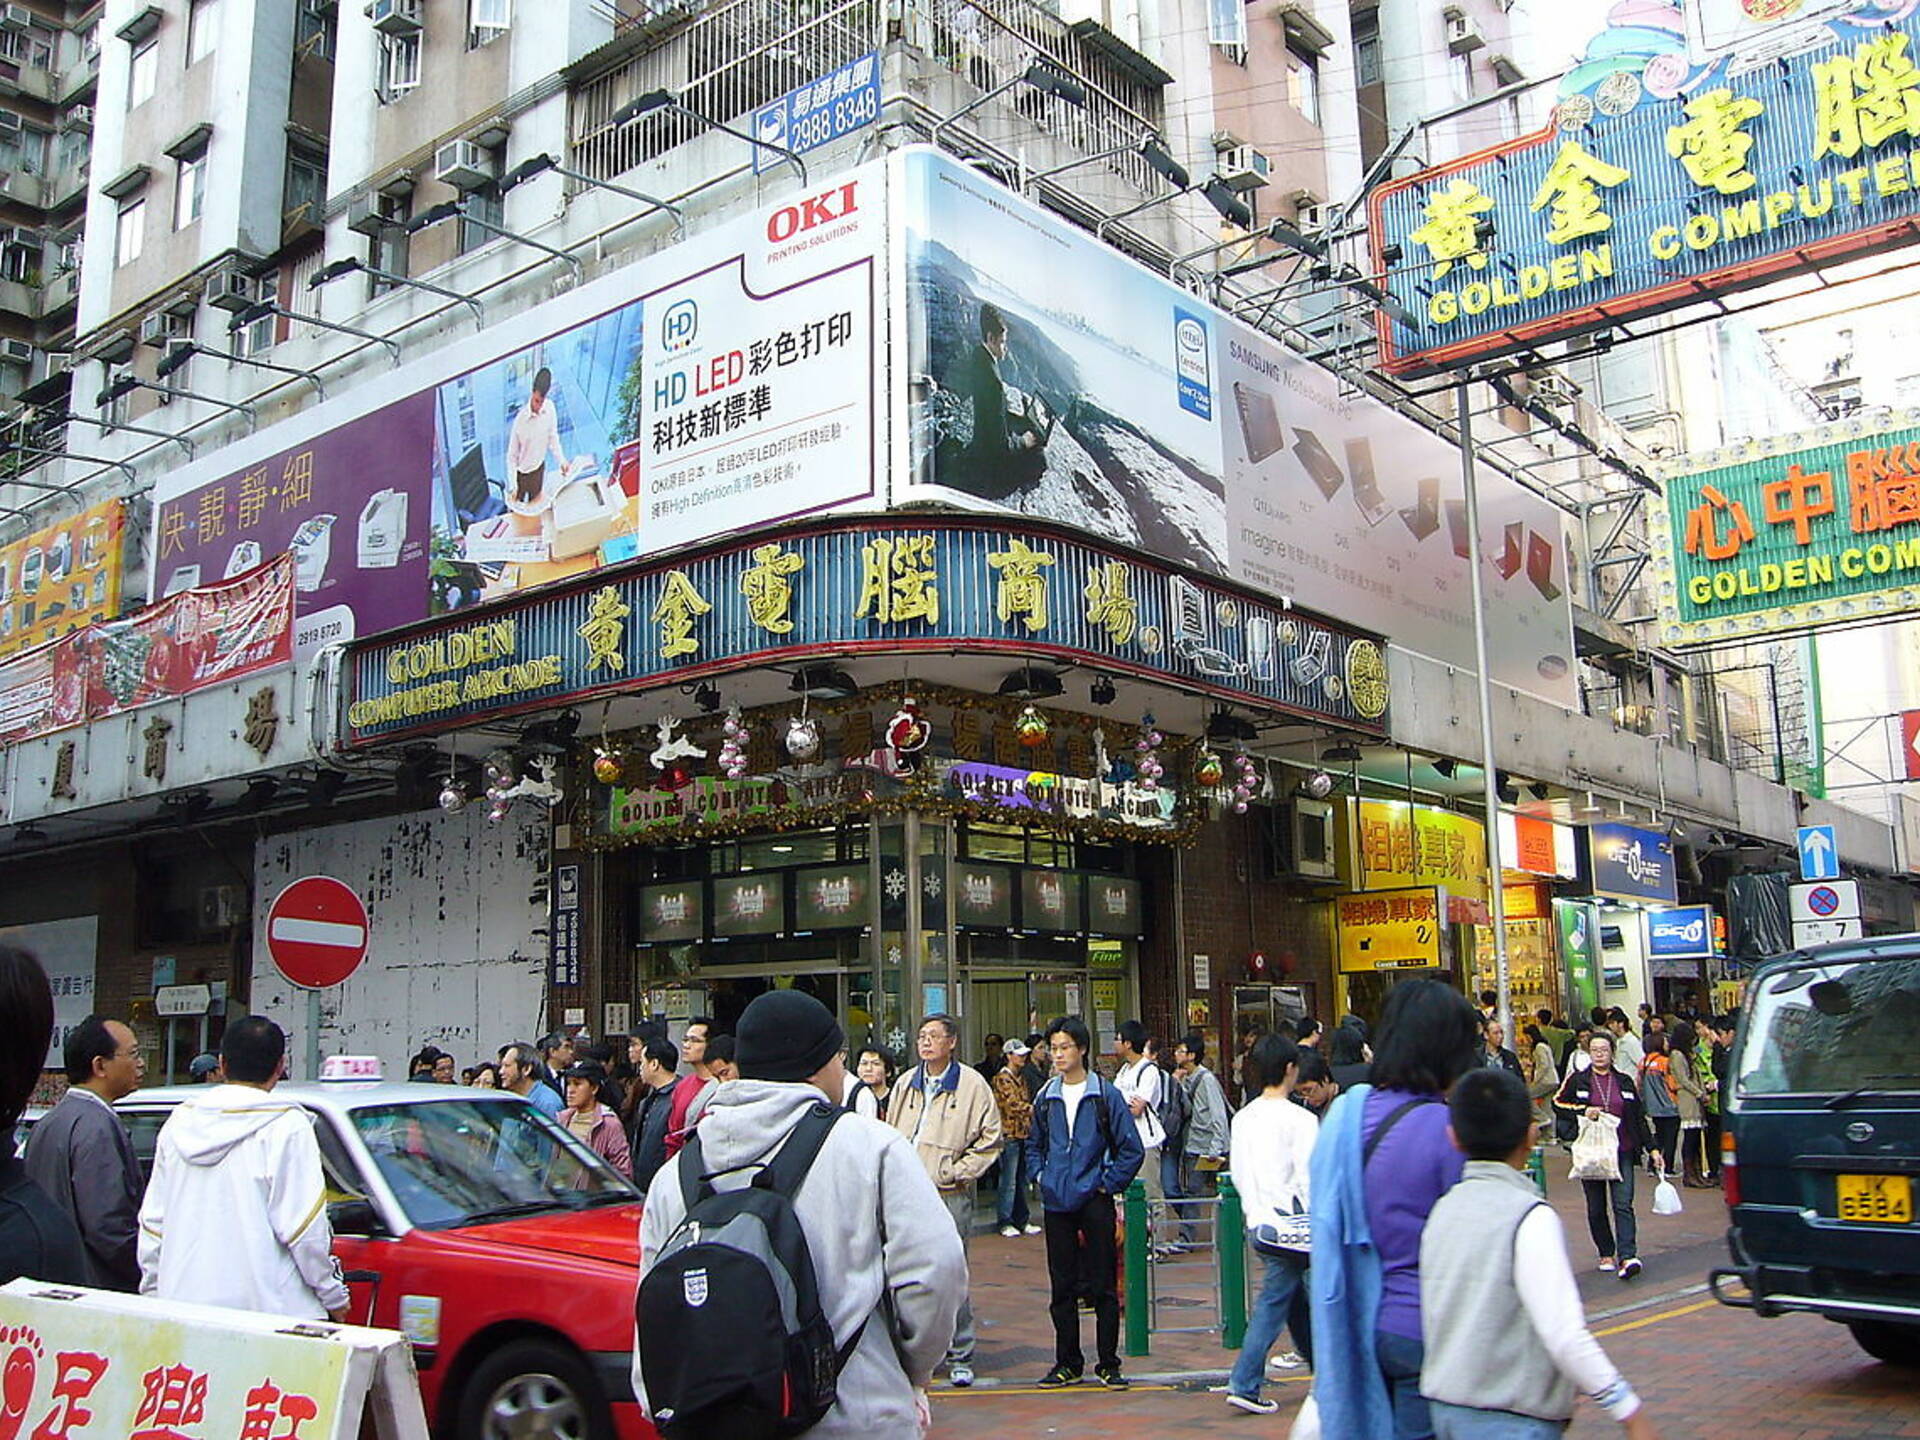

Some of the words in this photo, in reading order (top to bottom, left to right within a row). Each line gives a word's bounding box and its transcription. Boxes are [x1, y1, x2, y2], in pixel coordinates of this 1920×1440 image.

[793, 109, 832, 152] 2988
[835, 87, 877, 132] 8348
[767, 180, 858, 243] OKI
[1428, 244, 1614, 325] GOLDEN
[667, 312, 692, 340] HD
[654, 371, 687, 412] HD
[695, 350, 744, 397] LED
[749, 311, 852, 376] 彩色打印
[1229, 340, 1280, 382] SAMSUNG
[652, 384, 772, 455] 科技新標準
[1241, 521, 1287, 559] imagine
[1689, 555, 1833, 604] GOLDEN
[387, 619, 516, 683] GOLDEN
[349, 680, 462, 728] COMPUTER
[463, 655, 562, 701] ARCADE
[1835, 922, 1847, 937] 7
[342, 1060, 375, 1076] TAXI
